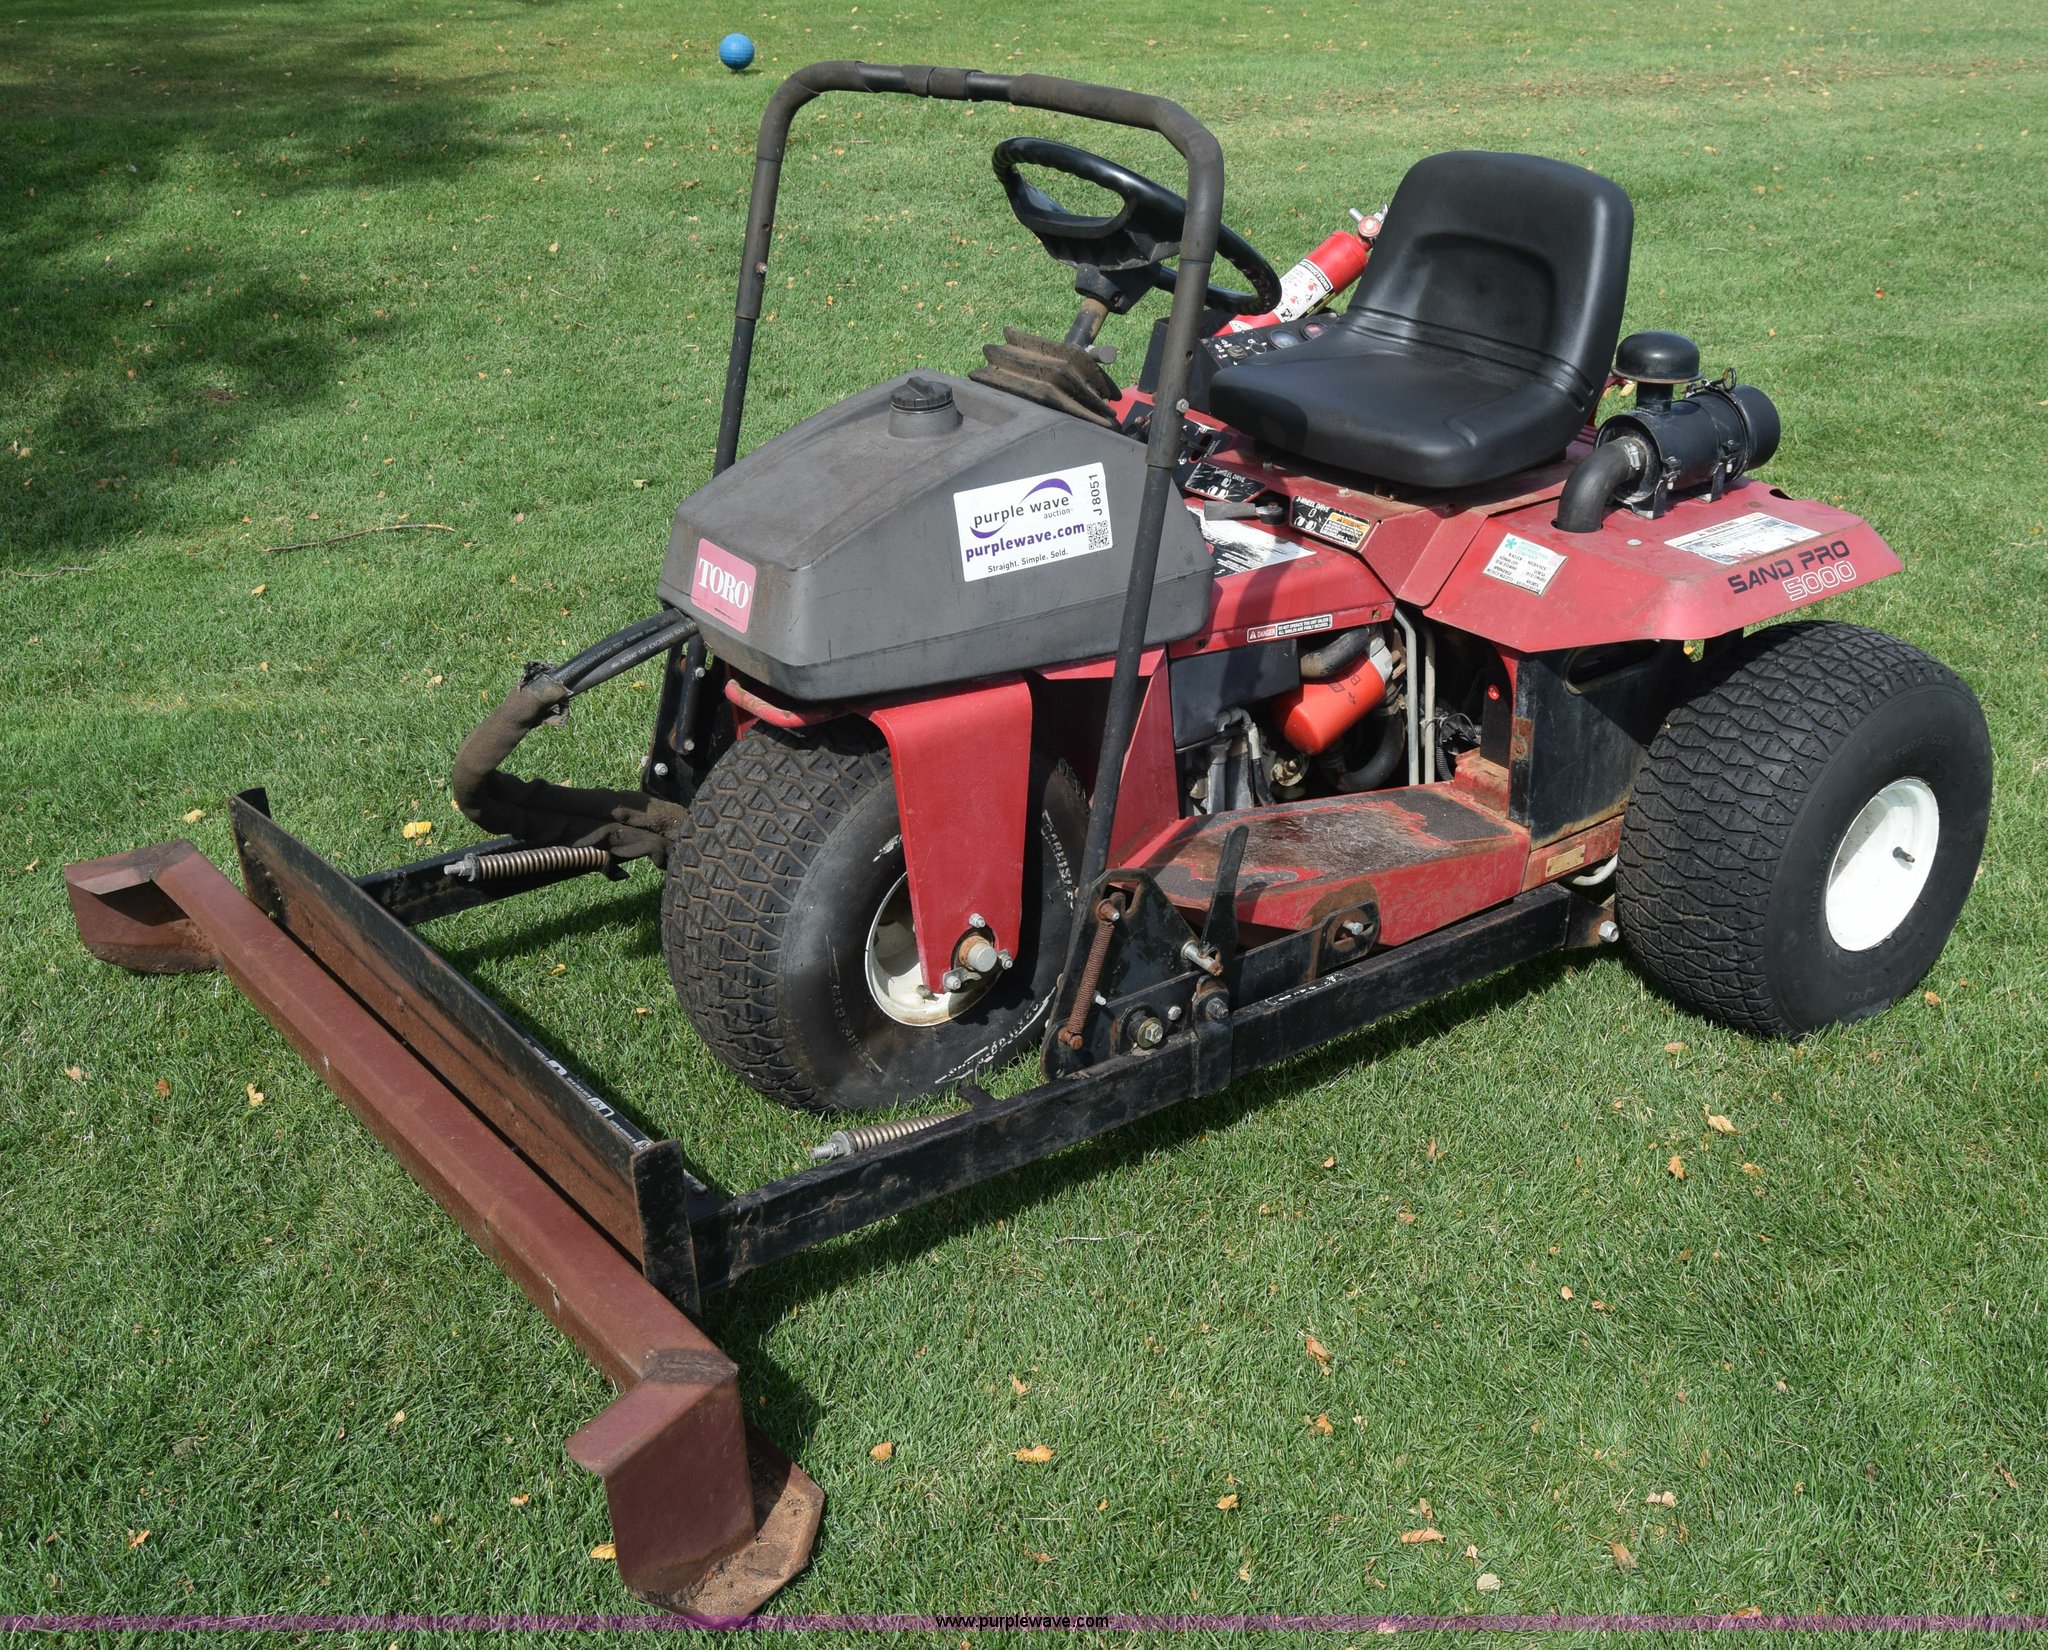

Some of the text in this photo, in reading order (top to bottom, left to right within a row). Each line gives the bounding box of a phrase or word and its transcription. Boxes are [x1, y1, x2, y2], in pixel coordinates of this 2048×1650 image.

[1089, 474, 1102, 506] 8051
[974, 496, 1070, 529] purple wave
[1043, 508, 1071, 520] auction
[965, 523, 1085, 562] purplewave.com
[988, 548, 1069, 573] Straight. Simple. Sold.
[698, 557, 749, 609] TORO
[1727, 559, 1795, 594] SAND
[1797, 540, 1850, 570] PRO
[1782, 560, 1857, 602] 5000
